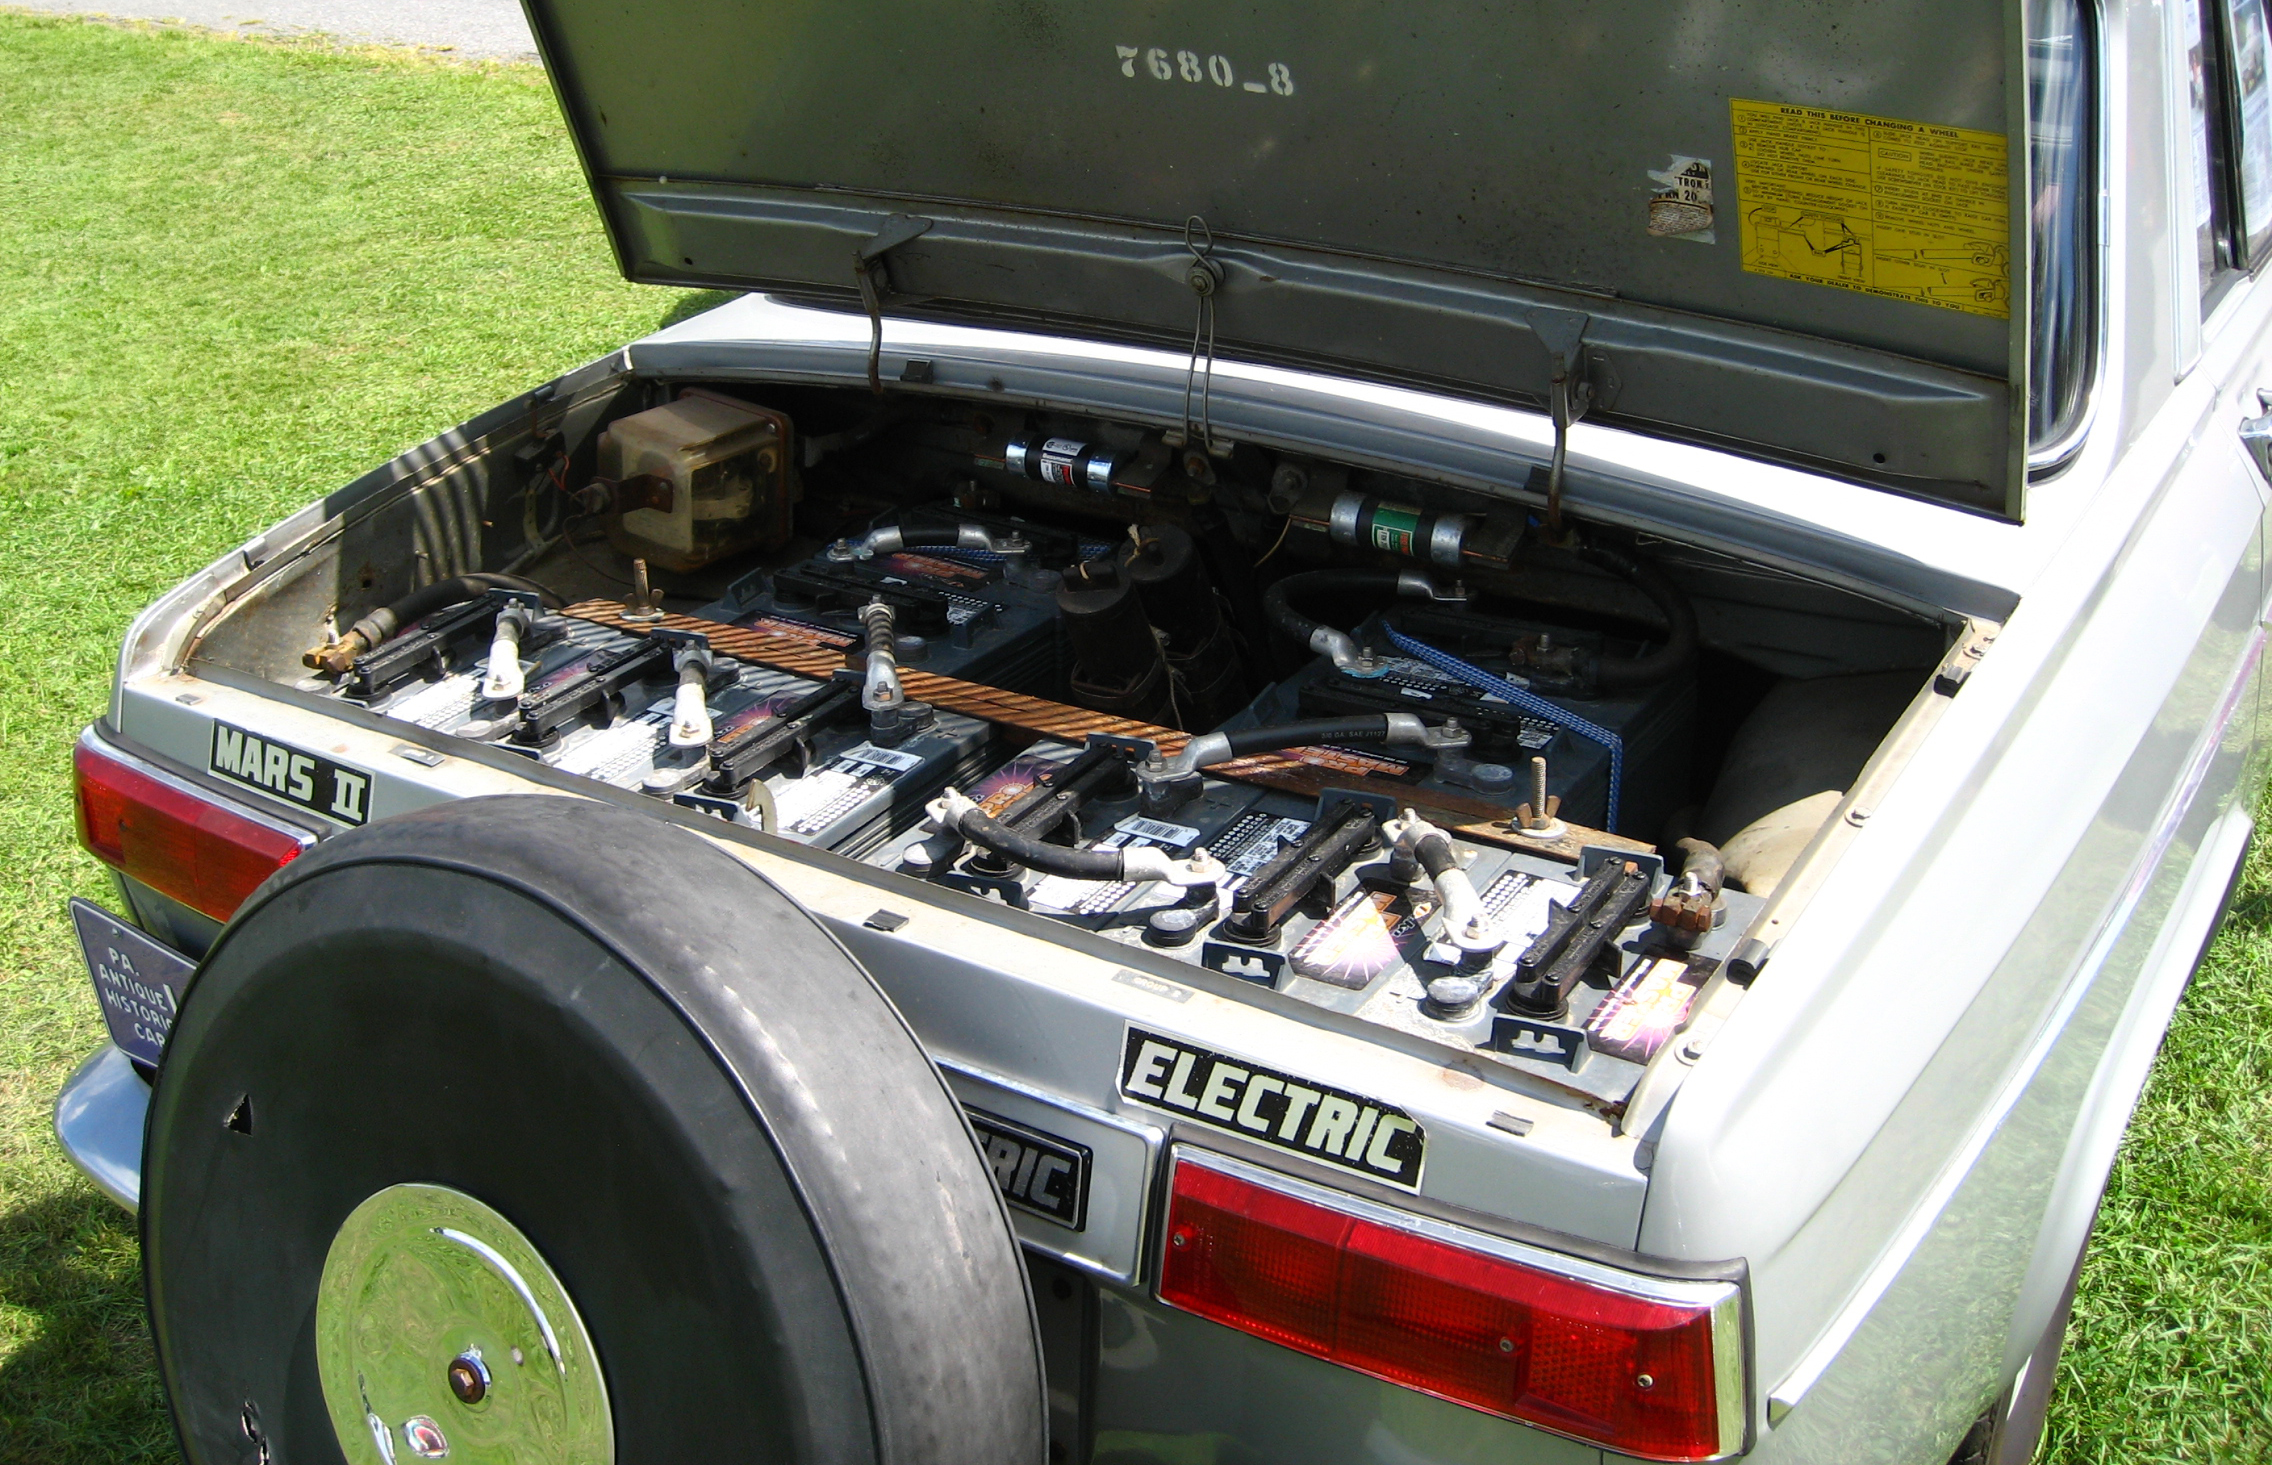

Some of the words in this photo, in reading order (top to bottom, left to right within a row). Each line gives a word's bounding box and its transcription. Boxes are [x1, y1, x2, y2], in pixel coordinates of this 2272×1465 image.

[1780, 107, 1802, 115] READ
[1807, 110, 1825, 118] THIS
[1830, 113, 1859, 123] BEFORE
[1864, 118, 1913, 131] CHANGING
[1929, 128, 1958, 137] WHEEL
[1827, 280, 1848, 288] DEALER
[1865, 287, 1910, 299] DEMONSTRATE
[215, 725, 316, 802] MARS
[330, 768, 366, 823] II
[108, 946, 140, 976] PA.
[99, 963, 168, 1012] ANTIQUE
[134, 1022, 166, 1048] CAR
[1126, 1039, 1416, 1174] ELECTRIC
